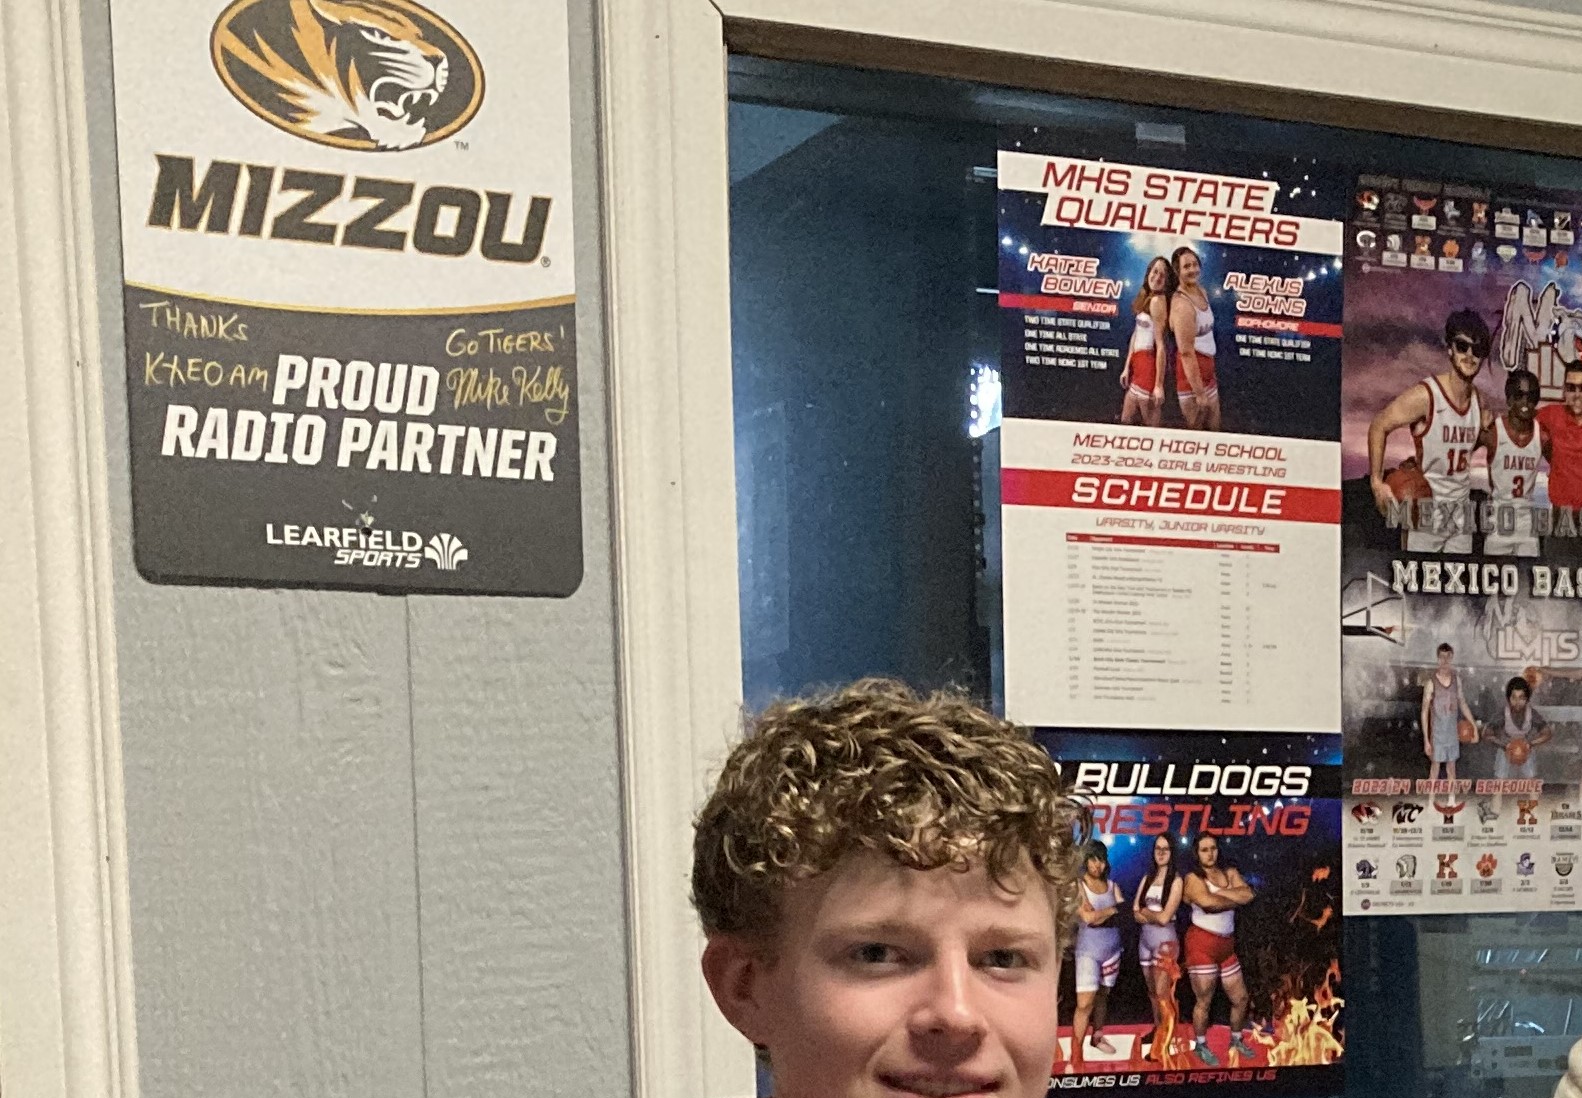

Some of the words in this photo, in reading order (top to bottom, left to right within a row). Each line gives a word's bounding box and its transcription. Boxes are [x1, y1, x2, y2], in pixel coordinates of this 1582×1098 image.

[1041, 161, 1134, 197] MHS
[1143, 174, 1271, 212] STATE
[145, 153, 553, 265] MIZZOU
[1055, 196, 1300, 247] QUALIFIERS
[1027, 252, 1100, 277] KATIE
[1041, 274, 1123, 299] BOWEN
[1223, 271, 1304, 297] ALEXUS
[1236, 293, 1307, 317] JOHNS
[139, 300, 248, 341] THANKS
[272, 353, 440, 417] PROUD
[161, 403, 327, 466] RADIO
[336, 416, 558, 481] PARTNER
[1073, 432, 1154, 453] MEXICO
[1158, 438, 1210, 456] HIGH
[1214, 442, 1288, 462] SCHOOL
[1443, 425, 1477, 443] DAWGS
[1071, 453, 1153, 469] 2023-2024
[1158, 459, 1202, 473] GIRLS
[1205, 462, 1287, 479] WRESTLING
[1503, 454, 1536, 471] DAWGS
[1071, 476, 1287, 516] SCHEDULE
[1512, 475, 1525, 498] 3
[265, 522, 424, 553] LEARFIELD
[1159, 520, 1209, 533] JUNIOR
[1211, 523, 1266, 536] VARSITY
[333, 546, 424, 570] SPORTS
[1392, 560, 1520, 596] MEXICO
[1074, 762, 1312, 796] BULLDOGS
[1415, 779, 1472, 795] VARSITY
[1087, 803, 1312, 836] RESTLING
[1119, 1075, 1141, 1087] US
[1146, 1073, 1185, 1086] ALSO
[1188, 1071, 1253, 1084] REFINES
[1256, 1069, 1278, 1082] US
